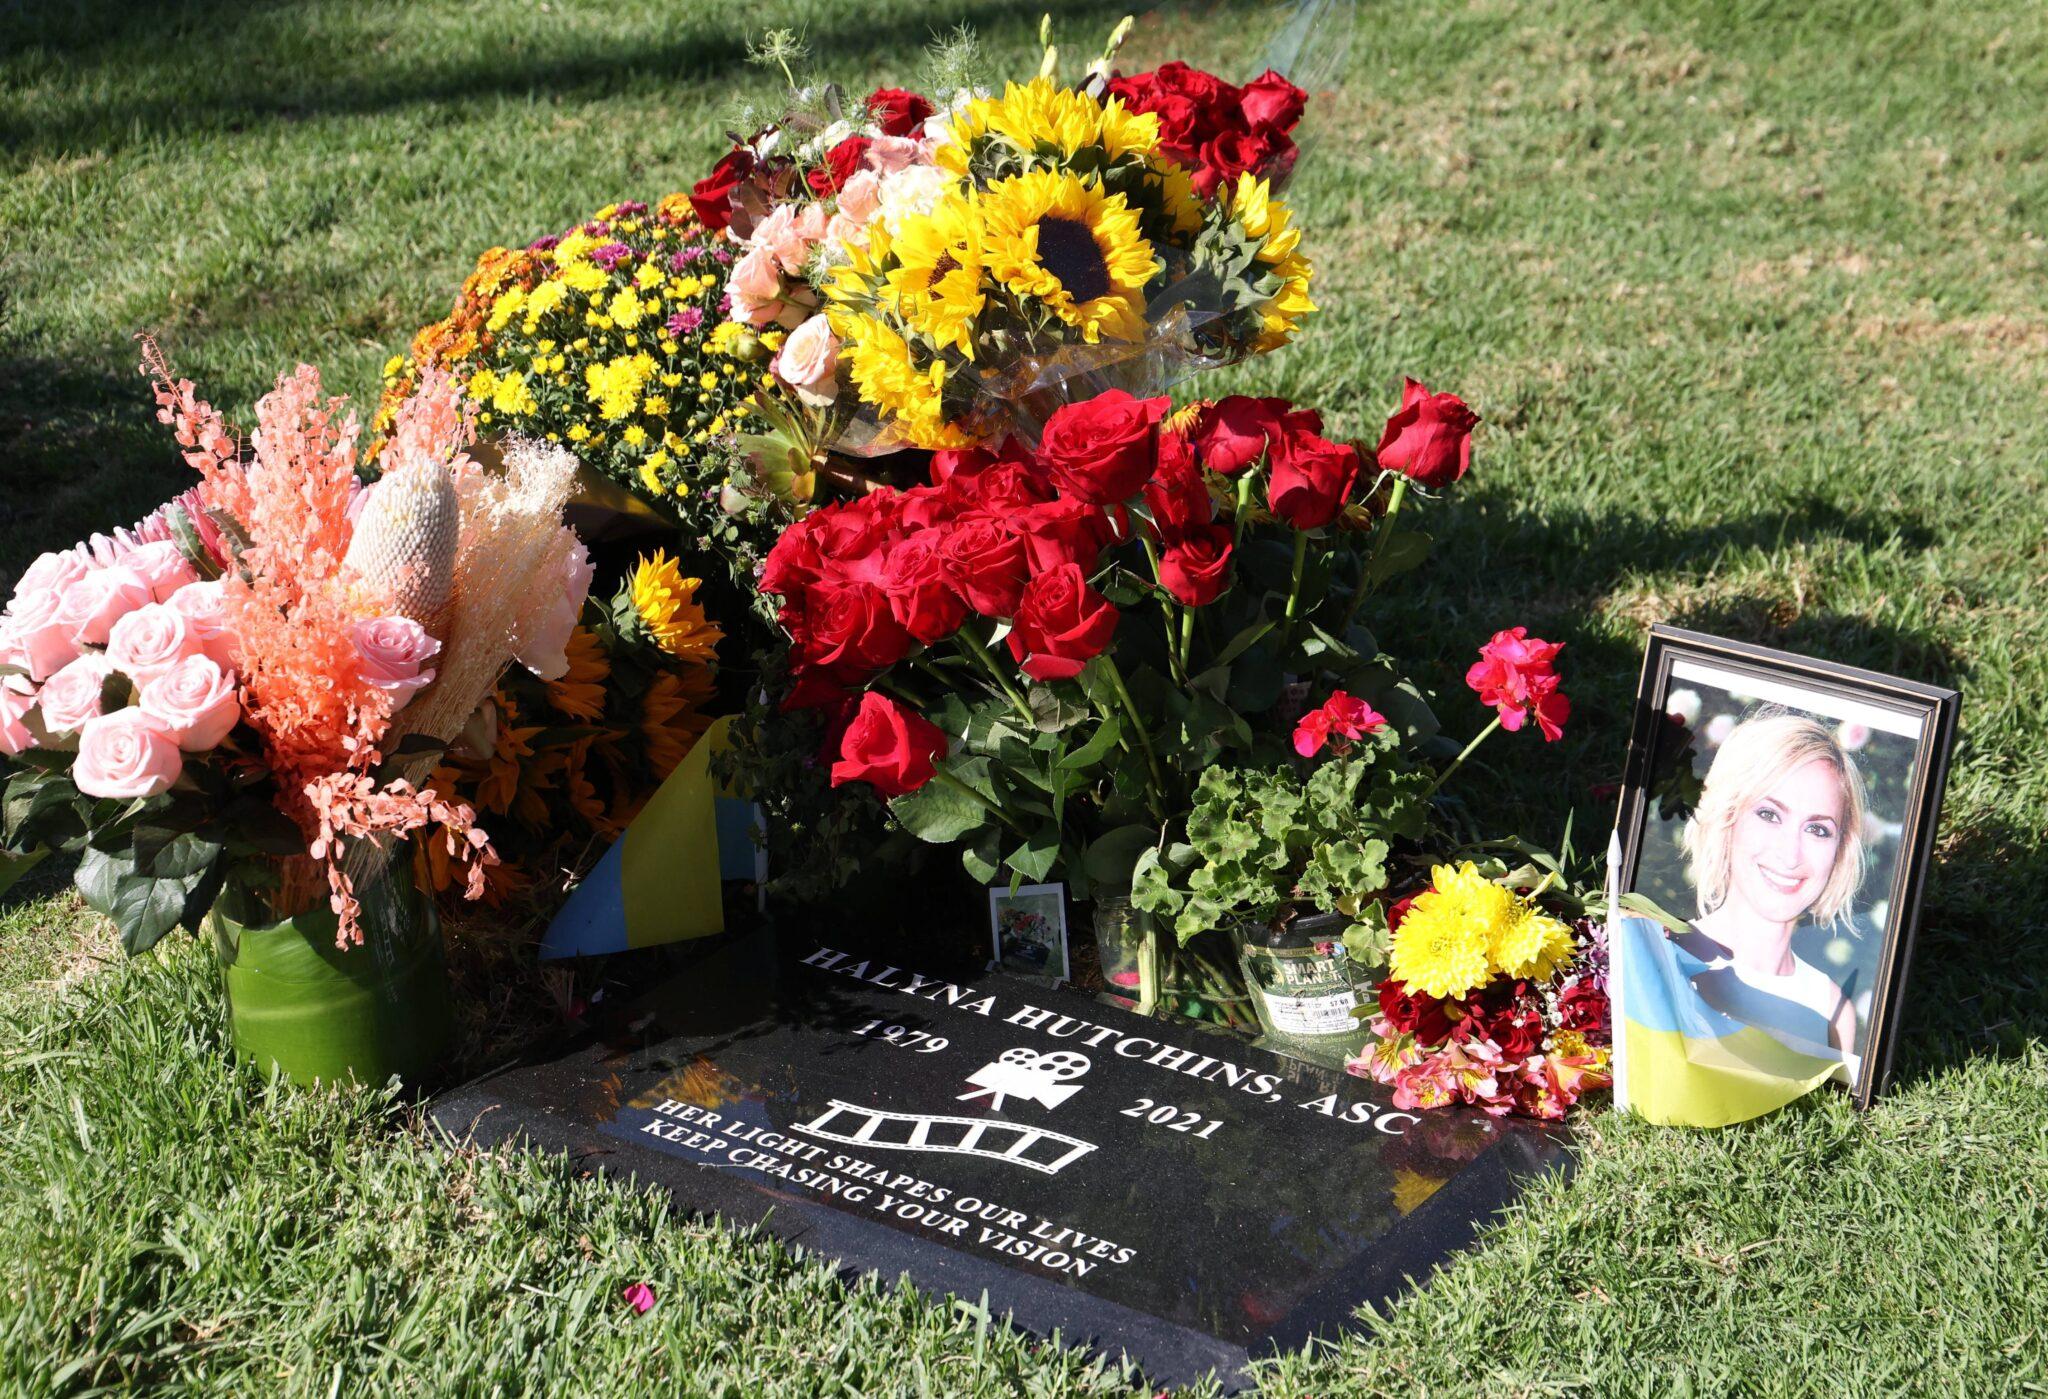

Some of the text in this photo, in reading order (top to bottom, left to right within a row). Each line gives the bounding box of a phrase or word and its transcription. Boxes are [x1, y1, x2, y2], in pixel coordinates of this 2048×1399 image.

[1283, 958, 1335, 975] SMART
[800, 946, 1422, 1135] HALYNA HUTCHINS, ASC
[851, 1018, 950, 1053] 1979
[1119, 1098, 1224, 1140] 2021
[639, 1118, 1098, 1277] KEEP CHASING YOUR VISION
[652, 1098, 1138, 1265] HER LIGHT SHAPES OUR LIVES
